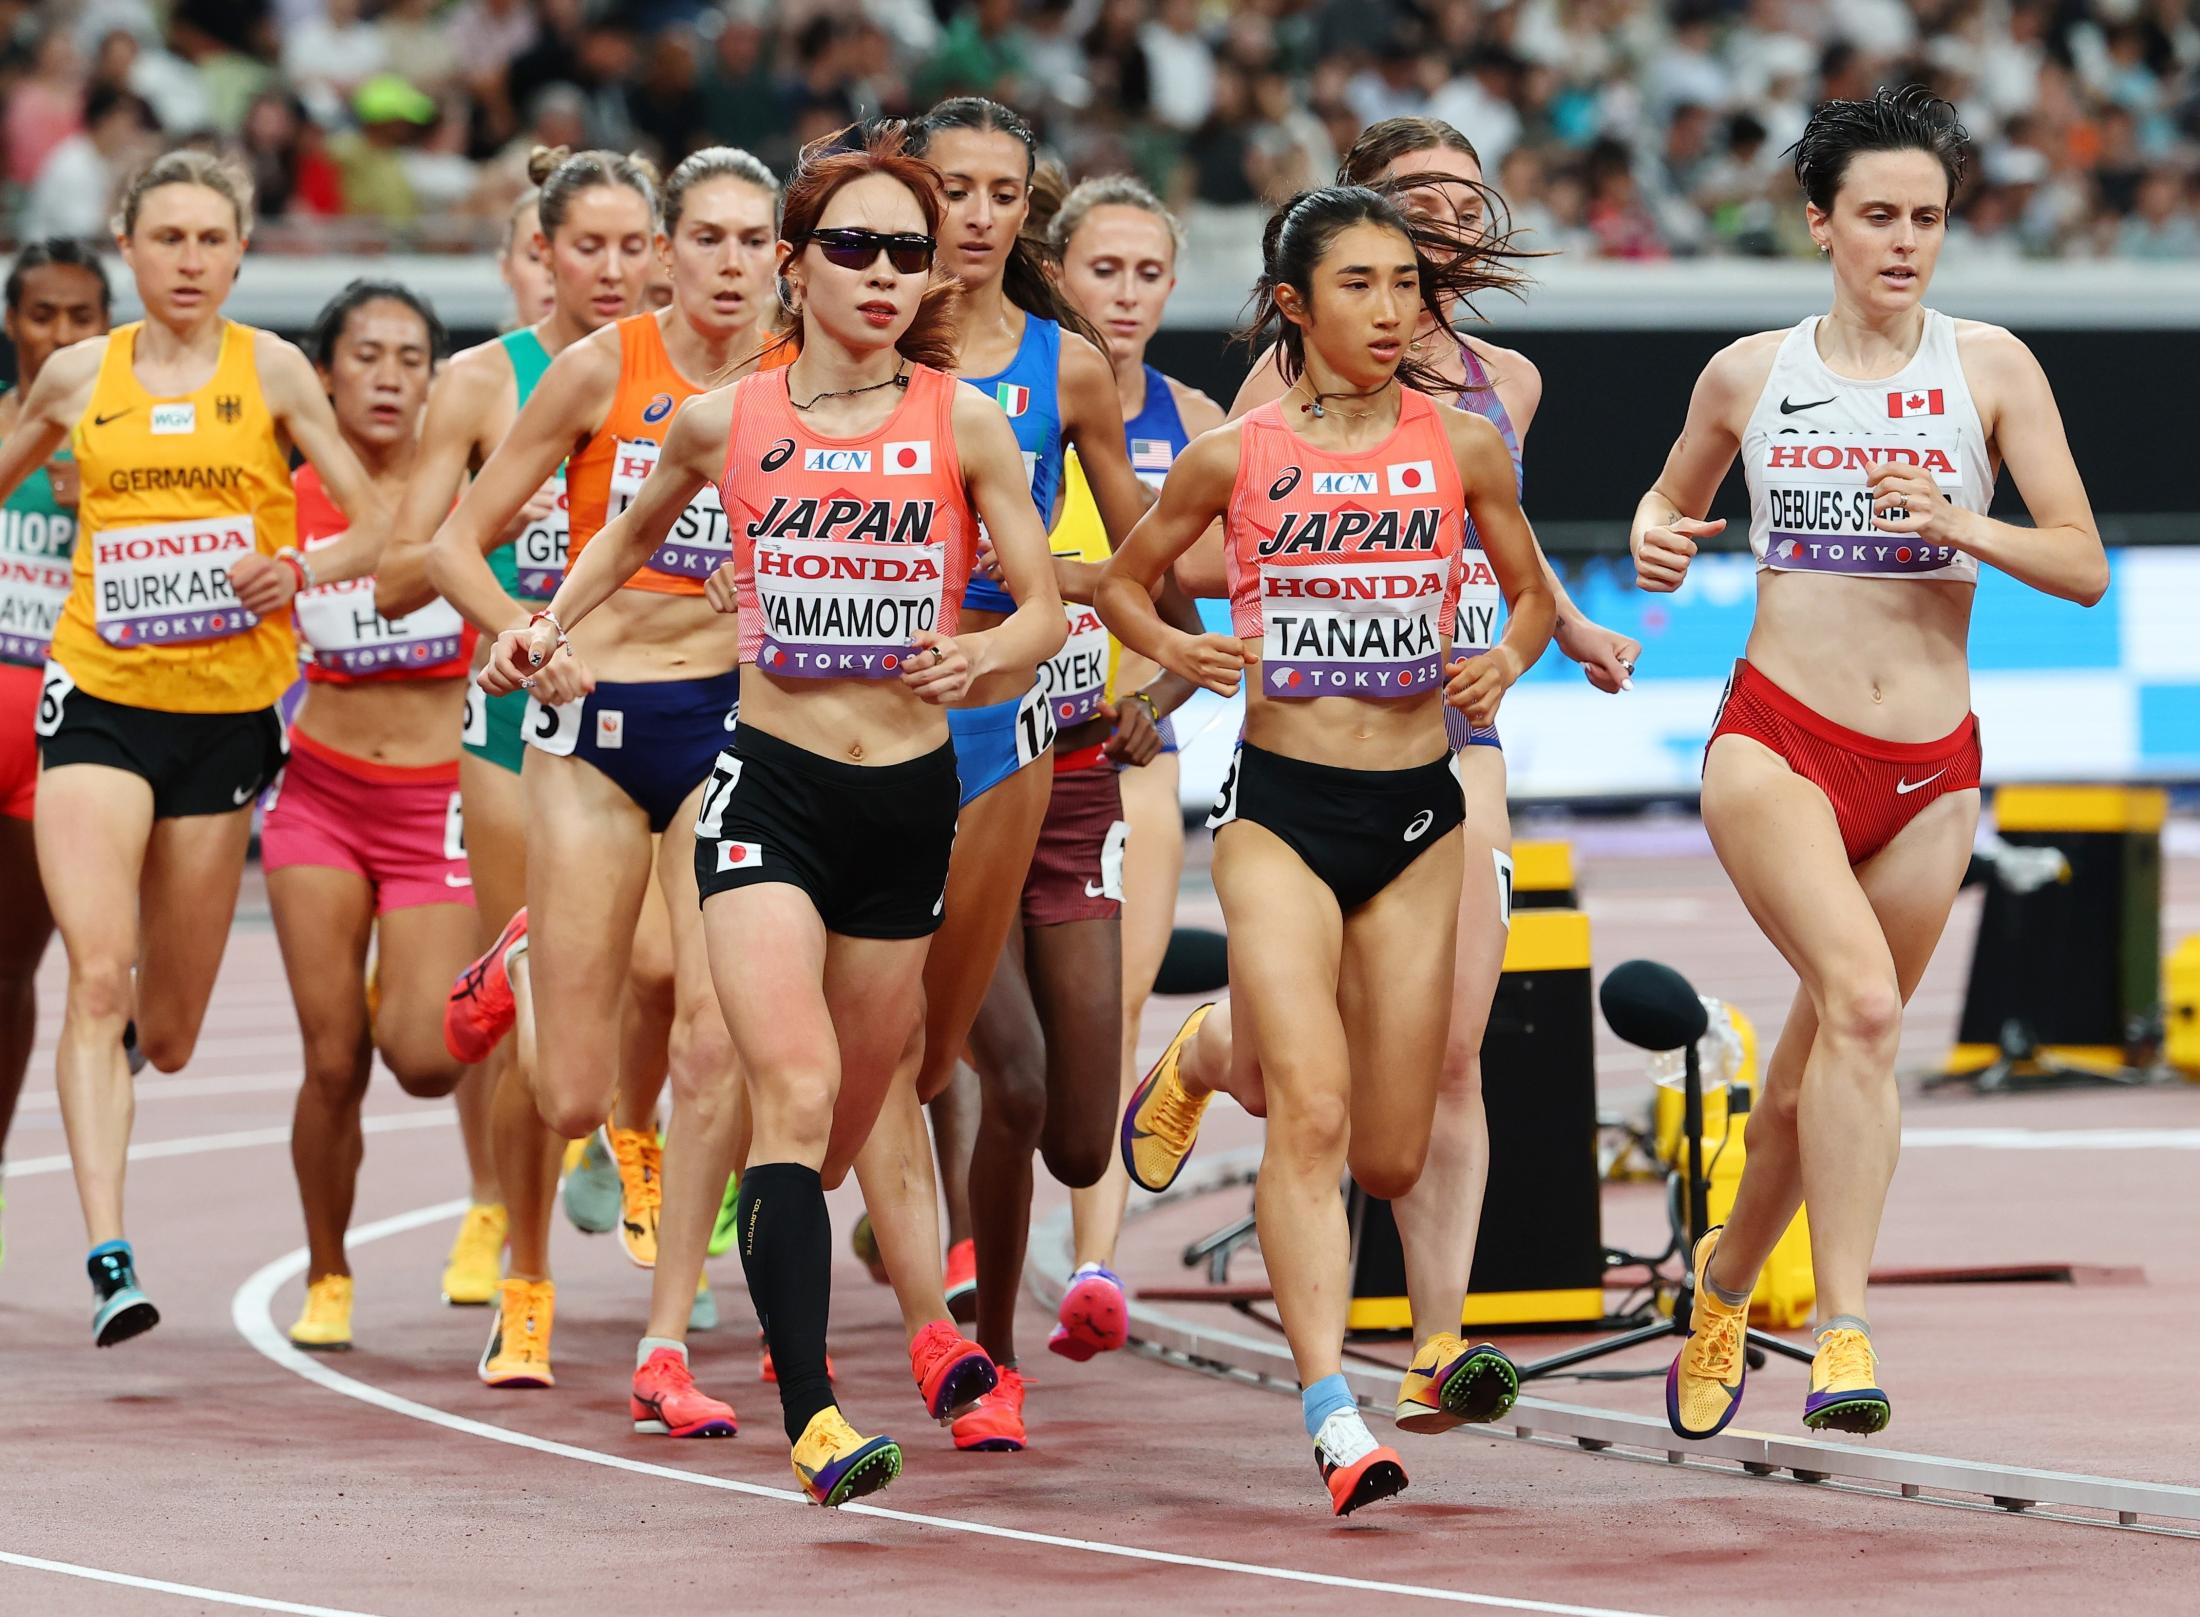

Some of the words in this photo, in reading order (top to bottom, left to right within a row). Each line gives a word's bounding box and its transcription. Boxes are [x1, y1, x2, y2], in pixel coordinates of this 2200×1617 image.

[109, 467, 244, 493] GERMANY
[807, 451, 869, 471] ACN
[1767, 445, 1957, 473] HONDA
[1315, 474, 1375, 493] ACN
[745, 496, 936, 545] JAPAN
[1258, 508, 1442, 557] JAPAN
[98, 530, 249, 563] HONDA
[757, 550, 940, 582] HONDA
[103, 567, 237, 613] BURKAR
[1264, 572, 1442, 600] HONDA
[761, 592, 935, 638] YAMAMOTO
[1272, 613, 1435, 657] TANAKA
[1020, 691, 1054, 760] 12
[698, 766, 735, 825] 7
[746, 1198, 762, 1256] COLANTOTTE
